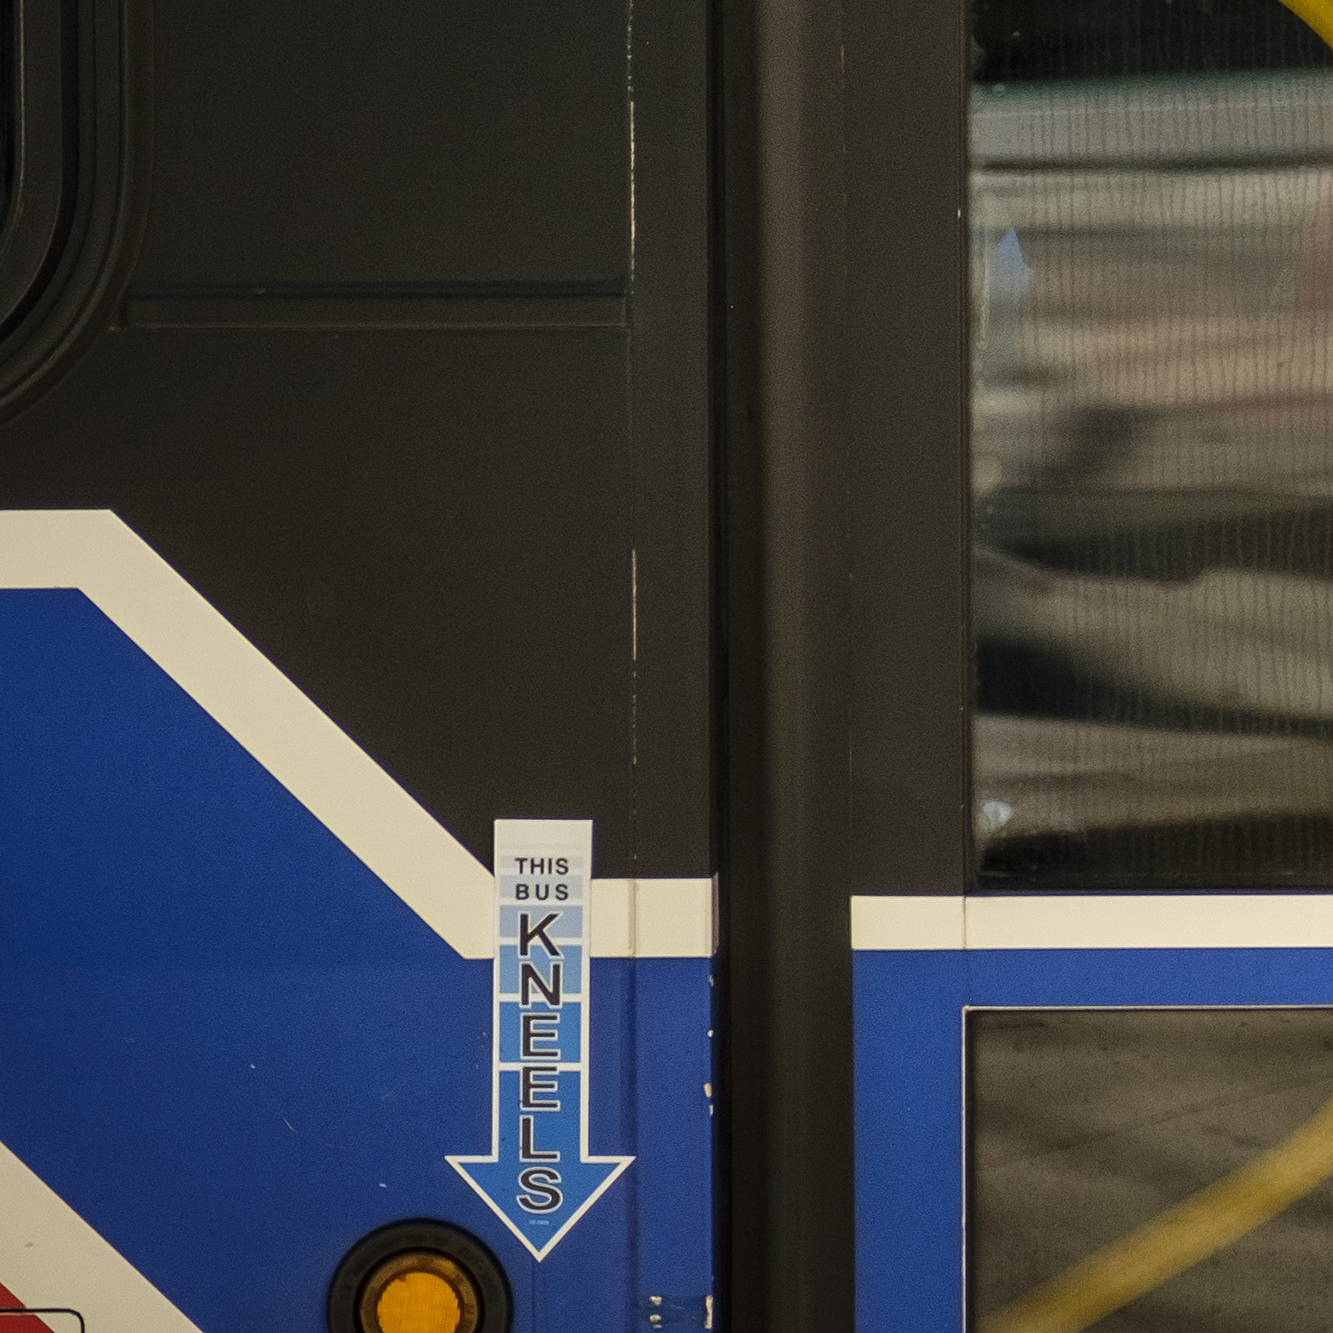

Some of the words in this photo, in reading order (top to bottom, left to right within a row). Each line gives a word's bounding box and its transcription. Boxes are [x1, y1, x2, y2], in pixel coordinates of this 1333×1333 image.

[515, 858, 568, 875] THIS
[516, 884, 568, 900] BUS
[517, 912, 562, 1211] KNEELS
